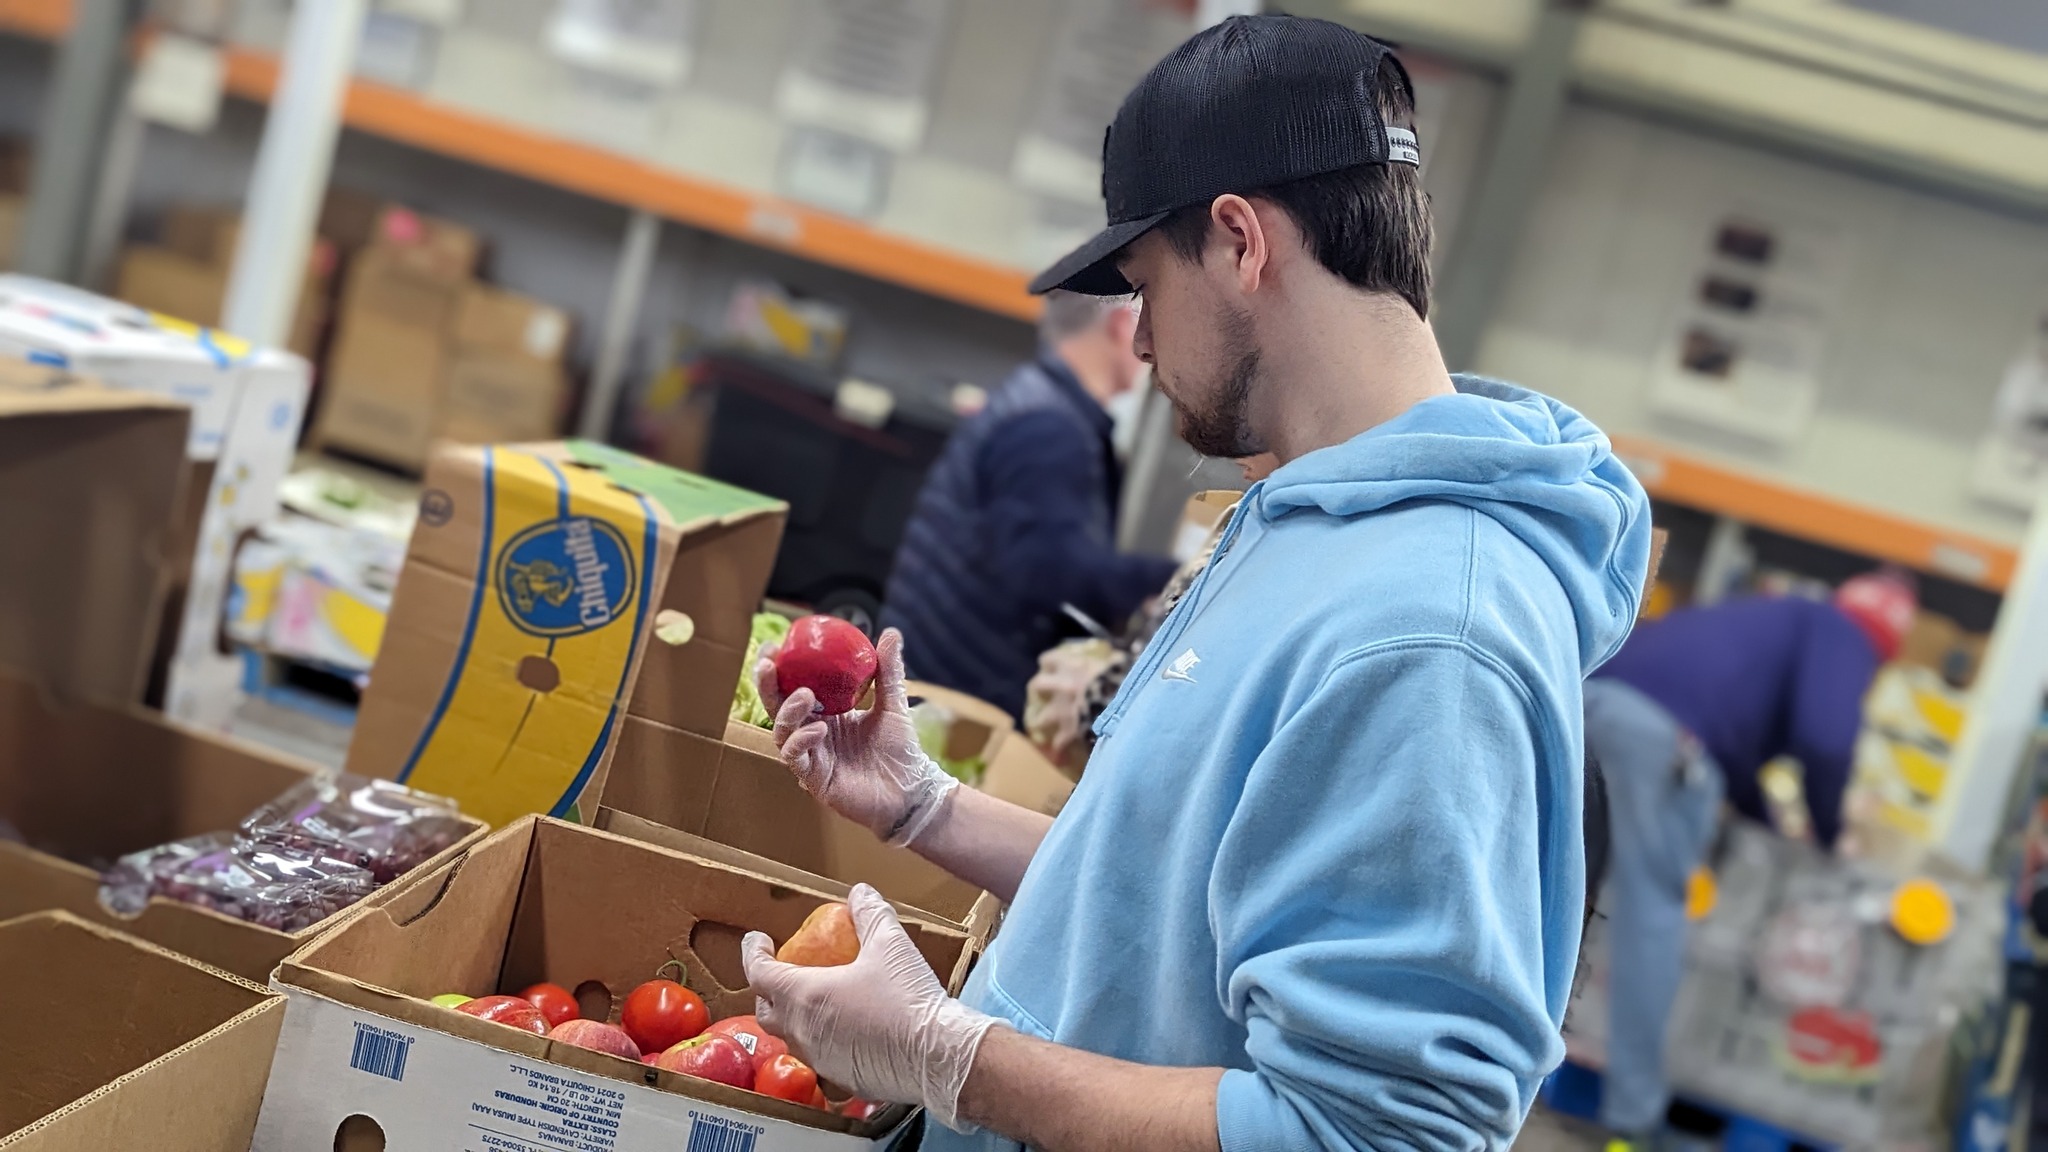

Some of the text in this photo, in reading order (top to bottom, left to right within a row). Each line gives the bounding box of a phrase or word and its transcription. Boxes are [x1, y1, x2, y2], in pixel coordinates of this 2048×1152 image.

[563, 518, 611, 627] Chiquita
[362, 1023, 382, 1034] 10403
[386, 1030, 406, 1041] 74904
[527, 1079, 539, 1088] KG
[529, 1070, 560, 1084] BRANDS
[540, 1082, 561, 1094] 18.14
[560, 1079, 595, 1094] CHIQUITA
[597, 1088, 617, 1098] 2021
[568, 1090, 579, 1099] LB
[580, 1093, 590, 1101] 40
[591, 1096, 606, 1106] WT:
[494, 1090, 619, 1128] COUNTRY OF ORIGIN: HONDURAS
[546, 1094, 622, 1119] MIN. LENGTH: 20 CM
[607, 1101, 624, 1110] NET
[471, 1102, 615, 1147] VARIETY: CAVENDISH TYPE (MUSA AAA)
[562, 1118, 617, 1138] CLASS: EXTRA
[688, 1110, 765, 1135] 0 74904 04011 0
[481, 1134, 527, 1152] 33004-2275
[538, 1131, 575, 1147] BANANAS
